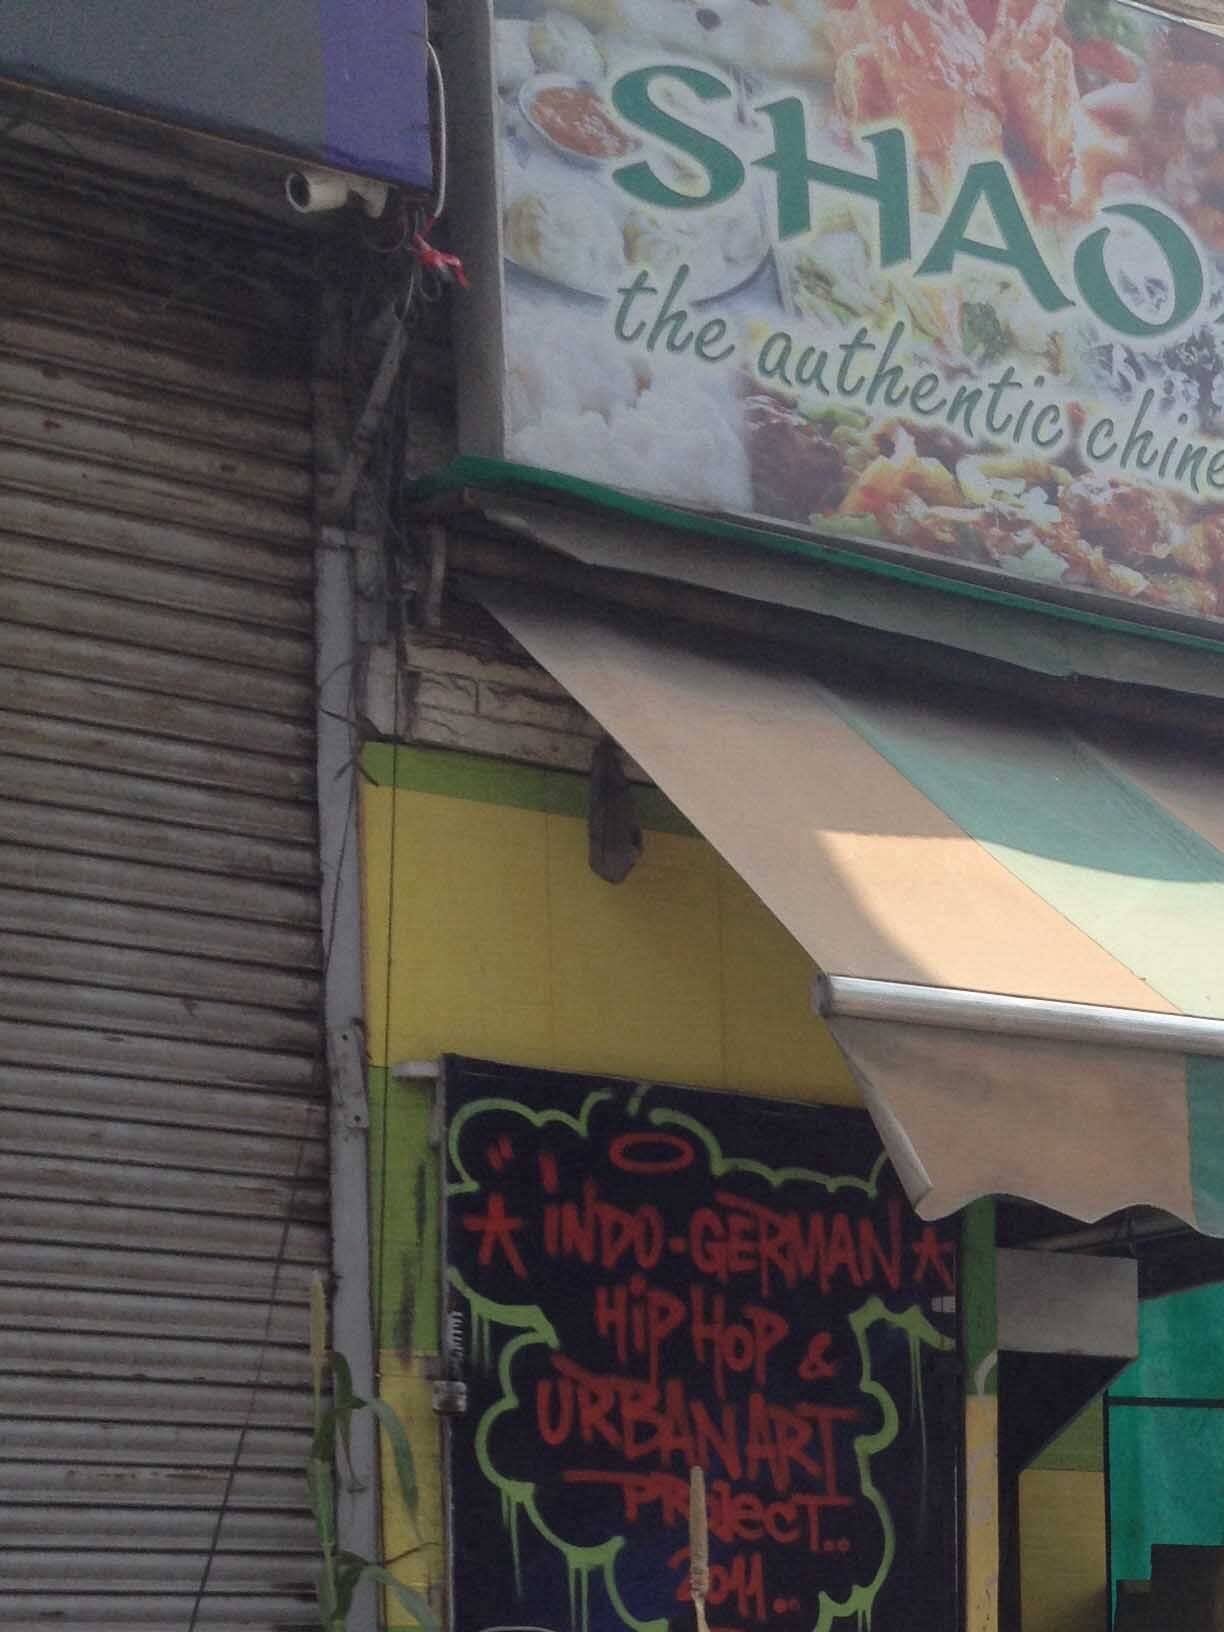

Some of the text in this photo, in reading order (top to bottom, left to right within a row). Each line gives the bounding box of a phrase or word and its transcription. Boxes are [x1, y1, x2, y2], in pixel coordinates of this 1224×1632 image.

[613, 264, 735, 363] the
[757, 321, 1063, 452] authentic
[798, 1331, 839, 1381] &
